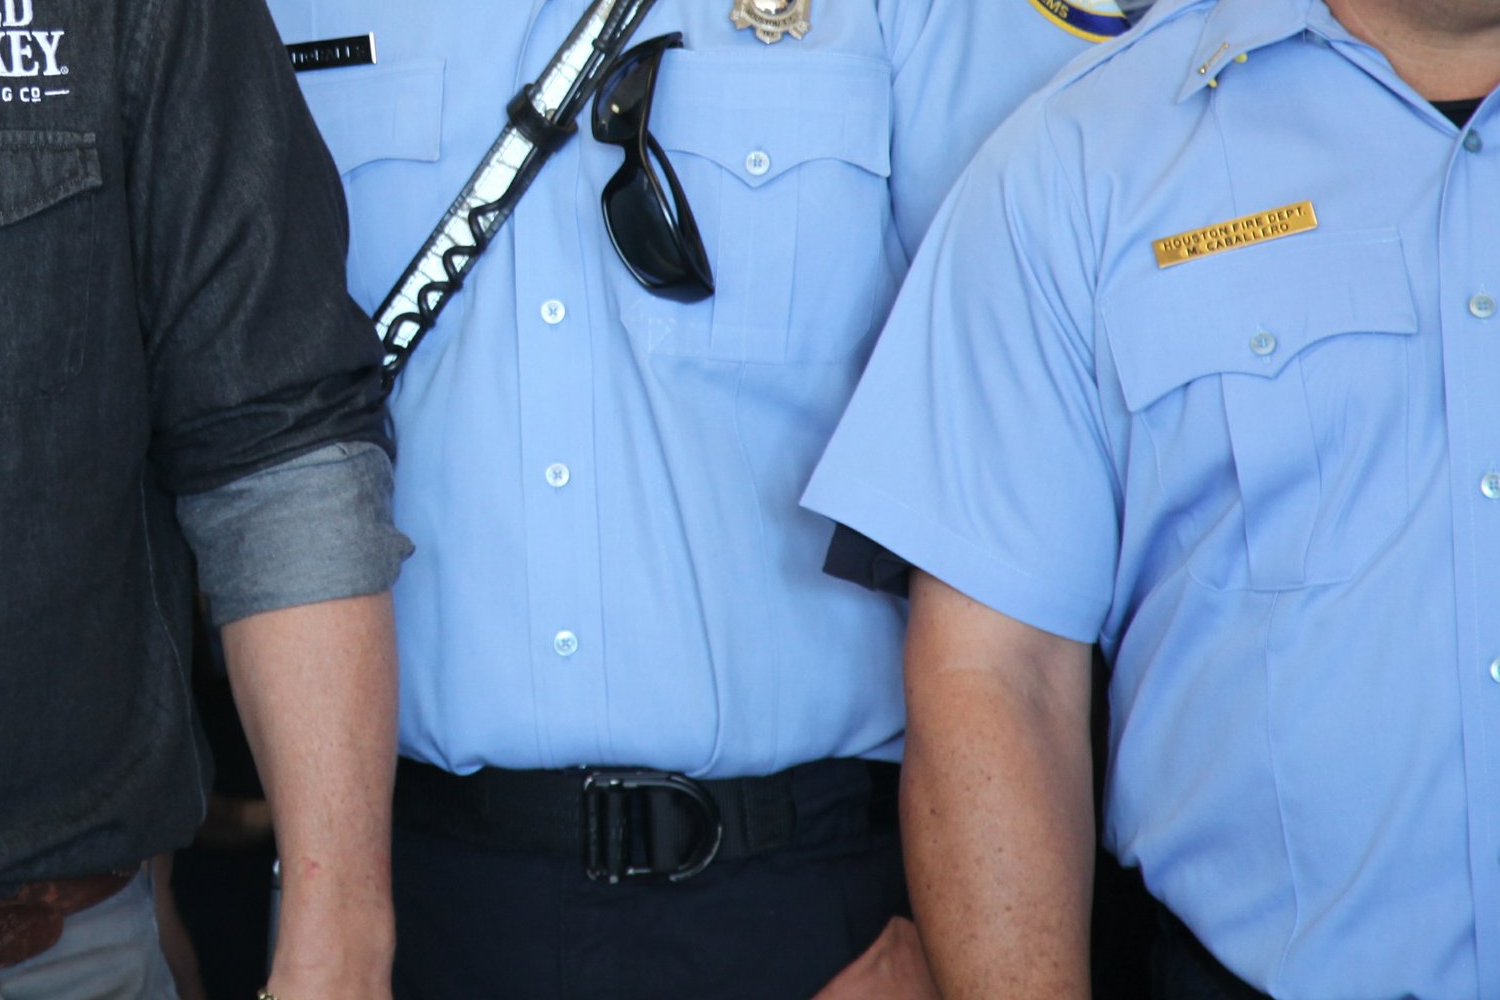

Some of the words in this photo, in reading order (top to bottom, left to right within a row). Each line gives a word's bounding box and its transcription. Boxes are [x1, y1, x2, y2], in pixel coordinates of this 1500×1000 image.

[1163, 225, 1228, 251] HOUSTON
[1232, 217, 1264, 233] FIRE
[1206, 223, 1289, 251] CABALLERO
